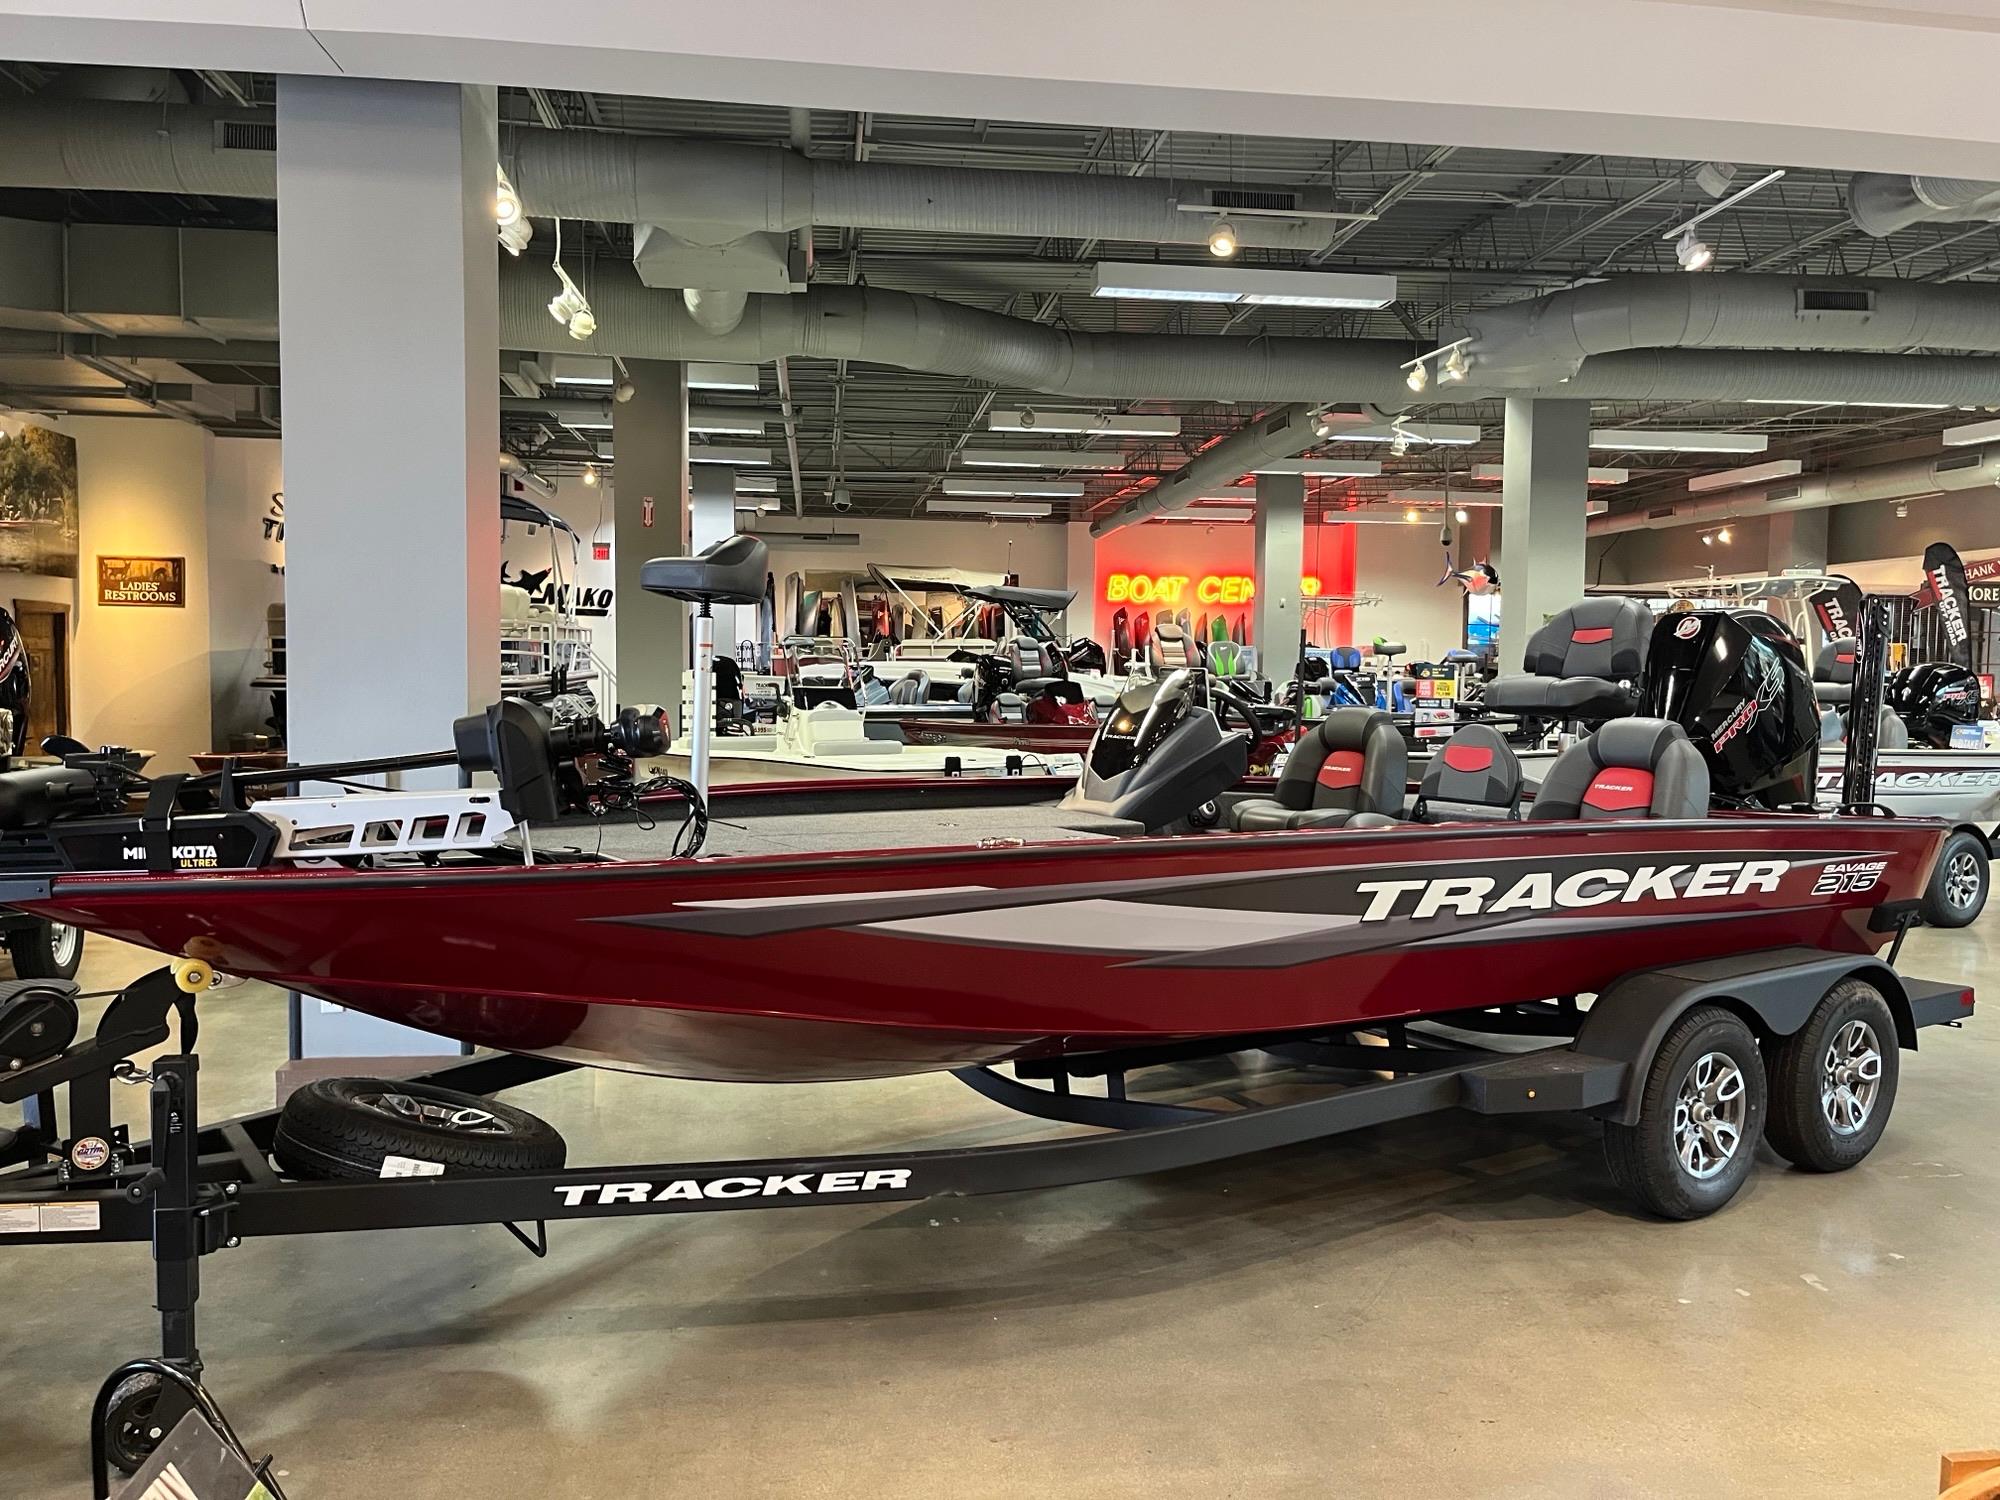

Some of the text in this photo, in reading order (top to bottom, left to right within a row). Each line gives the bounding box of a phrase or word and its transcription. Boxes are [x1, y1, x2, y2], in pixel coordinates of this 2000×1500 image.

[1965, 563, 1996, 579] HANK
[104, 590, 177, 602] RESTROOMS
[119, 581, 160, 592] LADIES'
[1107, 575, 1321, 604] BOAT CENR
[1933, 565, 1967, 642] TRACKER
[1824, 597, 1853, 638] TRAC
[1945, 621, 1957, 646] ROAD
[0, 631, 19, 672] RCURY
[1710, 698, 1746, 741] MERCURY
[1594, 783, 1633, 792] TRACKER
[1817, 772, 2000, 788] TACKER
[123, 845, 217, 860] MI KOTA
[180, 858, 218, 868] ULTREX
[1823, 861, 1888, 873] SAVAGE
[1355, 860, 1791, 923] TRACKER
[1810, 870, 1882, 896] 215
[553, 1168, 913, 1206] TRACKER
